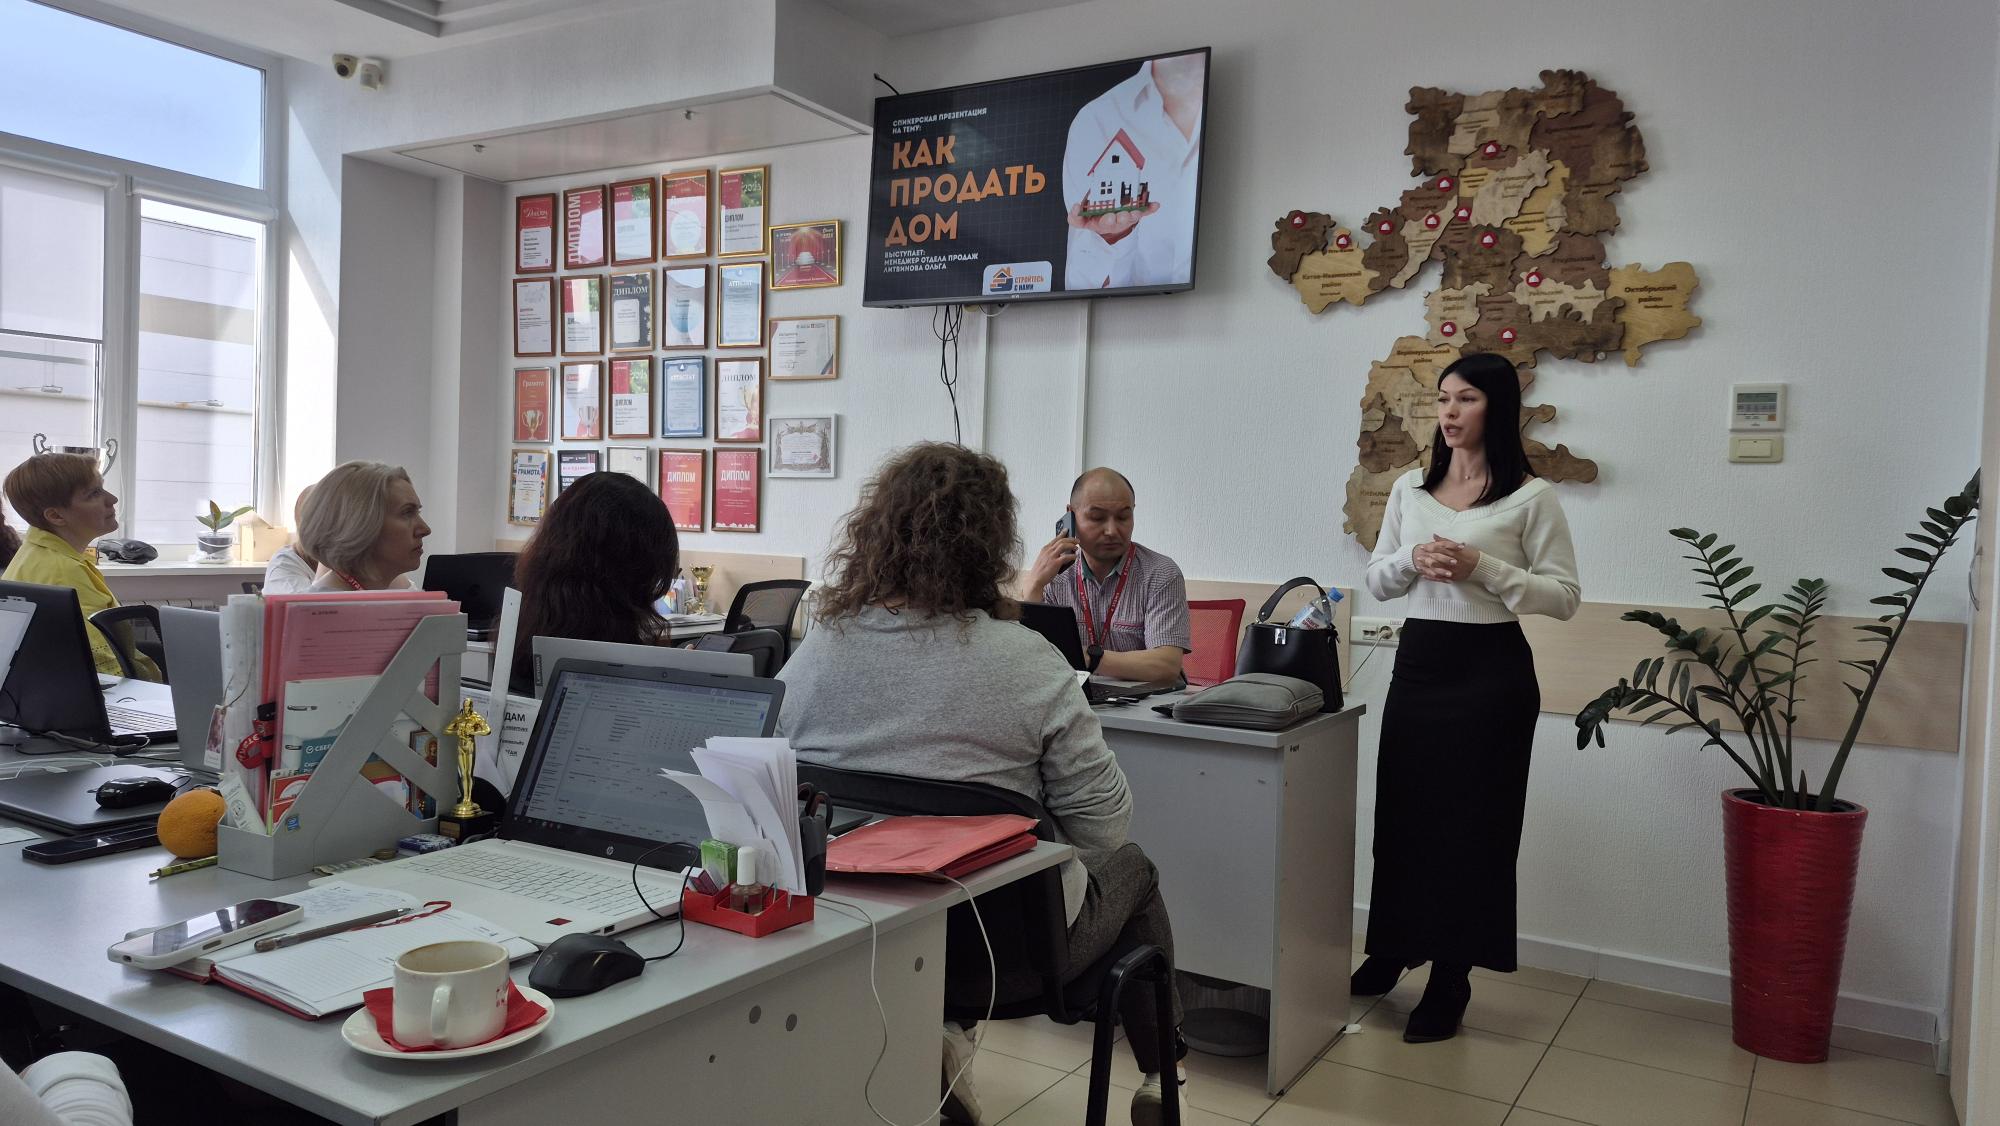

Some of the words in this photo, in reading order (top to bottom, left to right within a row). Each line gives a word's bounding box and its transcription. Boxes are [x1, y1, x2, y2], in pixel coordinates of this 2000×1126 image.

[893, 114, 938, 127] СПИКЕРСКАЯ
[938, 107, 987, 121] ПРЕЗЕНТАЦИЯ
[892, 126, 902, 134] НА
[903, 124, 922, 133] ТЕМУ:
[893, 135, 956, 170] КАК
[889, 164, 1046, 207] ПРОДАТЬ
[567, 192, 581, 264] ДИПЛОМ
[885, 211, 959, 247] ДОМ
[884, 249, 926, 258] ВЫСТУПАЕТ:
[884, 256, 920, 266] МЕНЕДЖЕР
[920, 254, 947, 264] ОТДЕЛА
[947, 252, 979, 262] ПРОДАЖ
[883, 264, 924, 273] ЛИТВИНОВА
[924, 262, 947, 271] ОЛЬГА
[613, 286, 648, 296] ДИПЛОМ
[1321, 281, 1342, 290] район
[1624, 284, 1677, 294] Октябрьский
[1638, 294, 1663, 304] район
[517, 468, 541, 476] ГРАМОТА
[667, 471, 696, 482] ДИПЛОМ
[720, 470, 751, 482] ДИПЛОМ
[1370, 499, 1388, 509] райо
